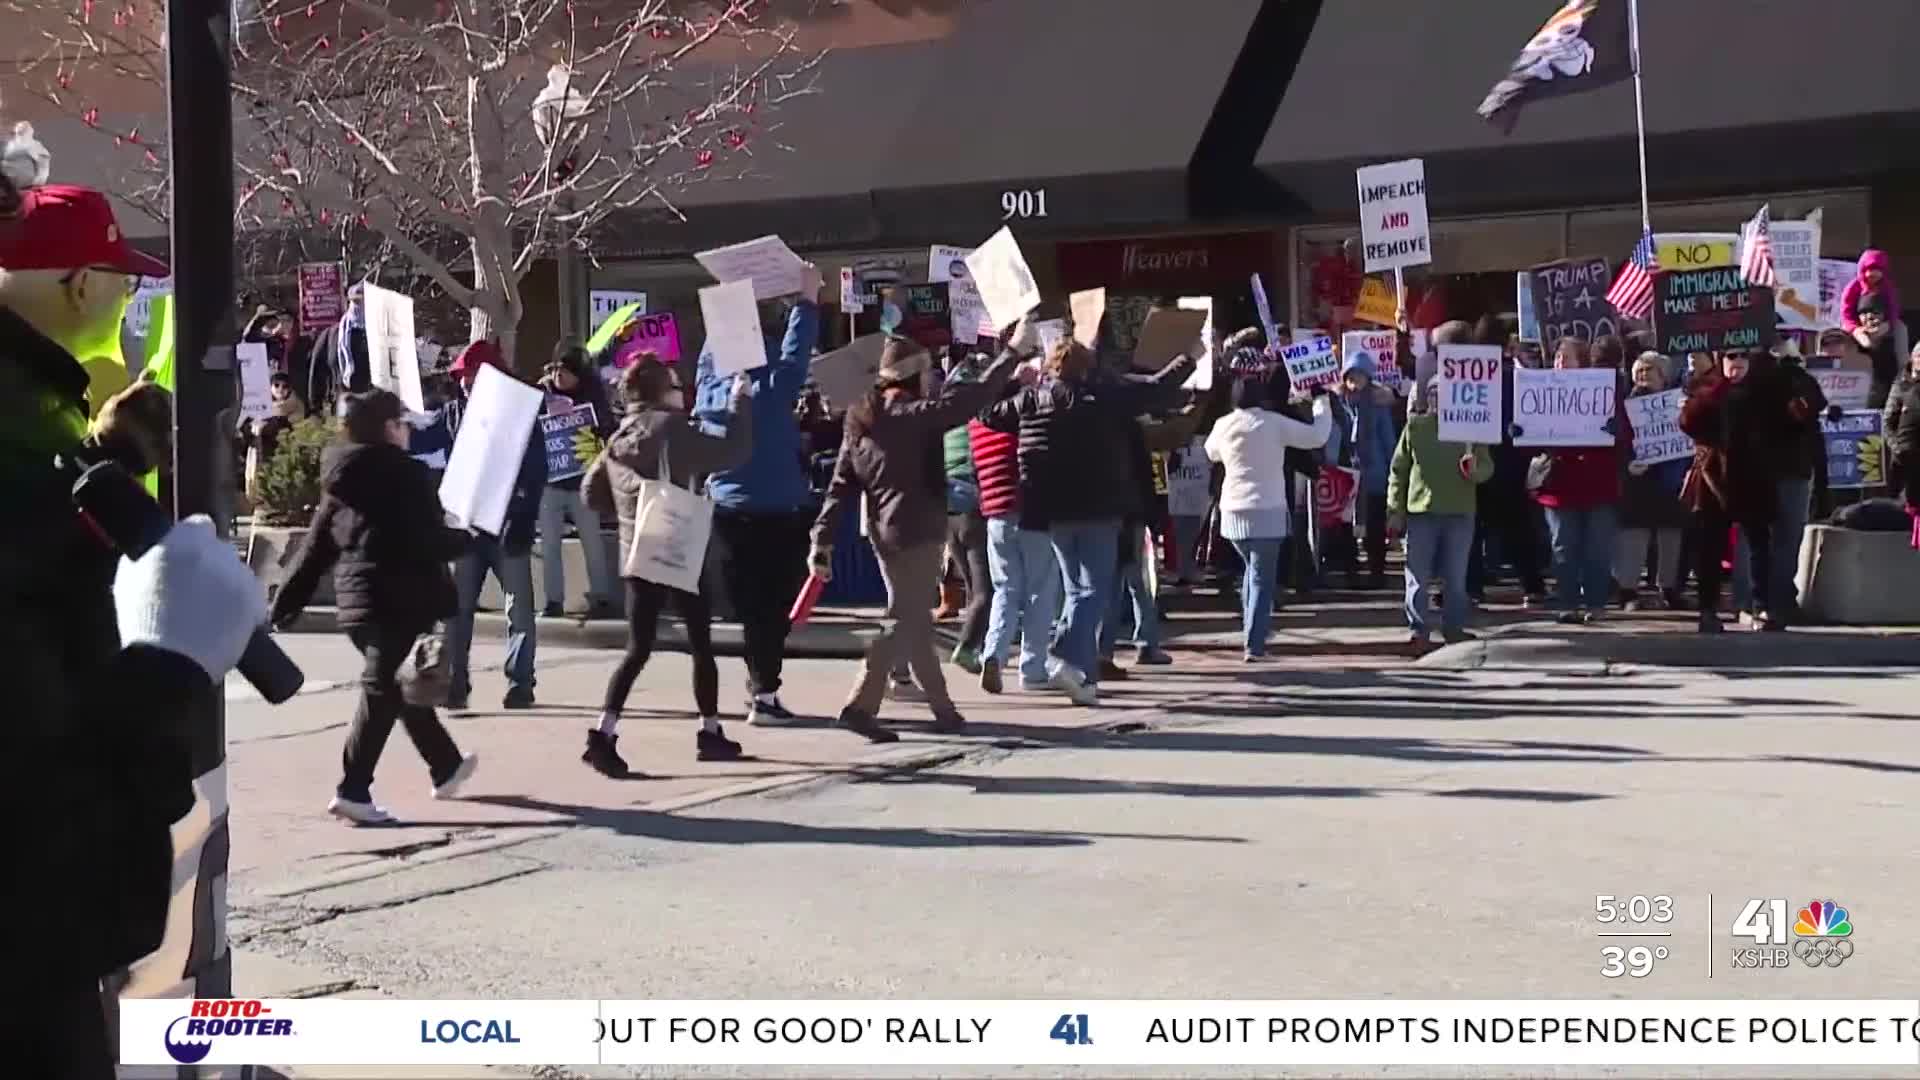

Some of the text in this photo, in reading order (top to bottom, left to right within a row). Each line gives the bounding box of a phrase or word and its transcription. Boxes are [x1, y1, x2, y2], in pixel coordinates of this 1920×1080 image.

[1361, 180, 1425, 204] IMPEACH
[1001, 189, 1048, 220] 901
[1381, 212, 1409, 231] AND
[1366, 236, 1426, 260] REMOVE
[1676, 244, 1711, 264] NO
[1538, 261, 1604, 293] TRUMP
[1670, 269, 1746, 296] IMMIGRAN
[1573, 287, 1597, 311] A
[1664, 297, 1696, 315] MAKE
[1668, 327, 1760, 353] AGAIN AGAIN
[1283, 345, 1309, 360] WHO
[1291, 354, 1335, 375] BEING
[1443, 357, 1498, 381] STOP
[1452, 382, 1489, 405] ICE
[1520, 385, 1616, 416] OUTRAGED
[1443, 408, 1491, 423] TERROR
